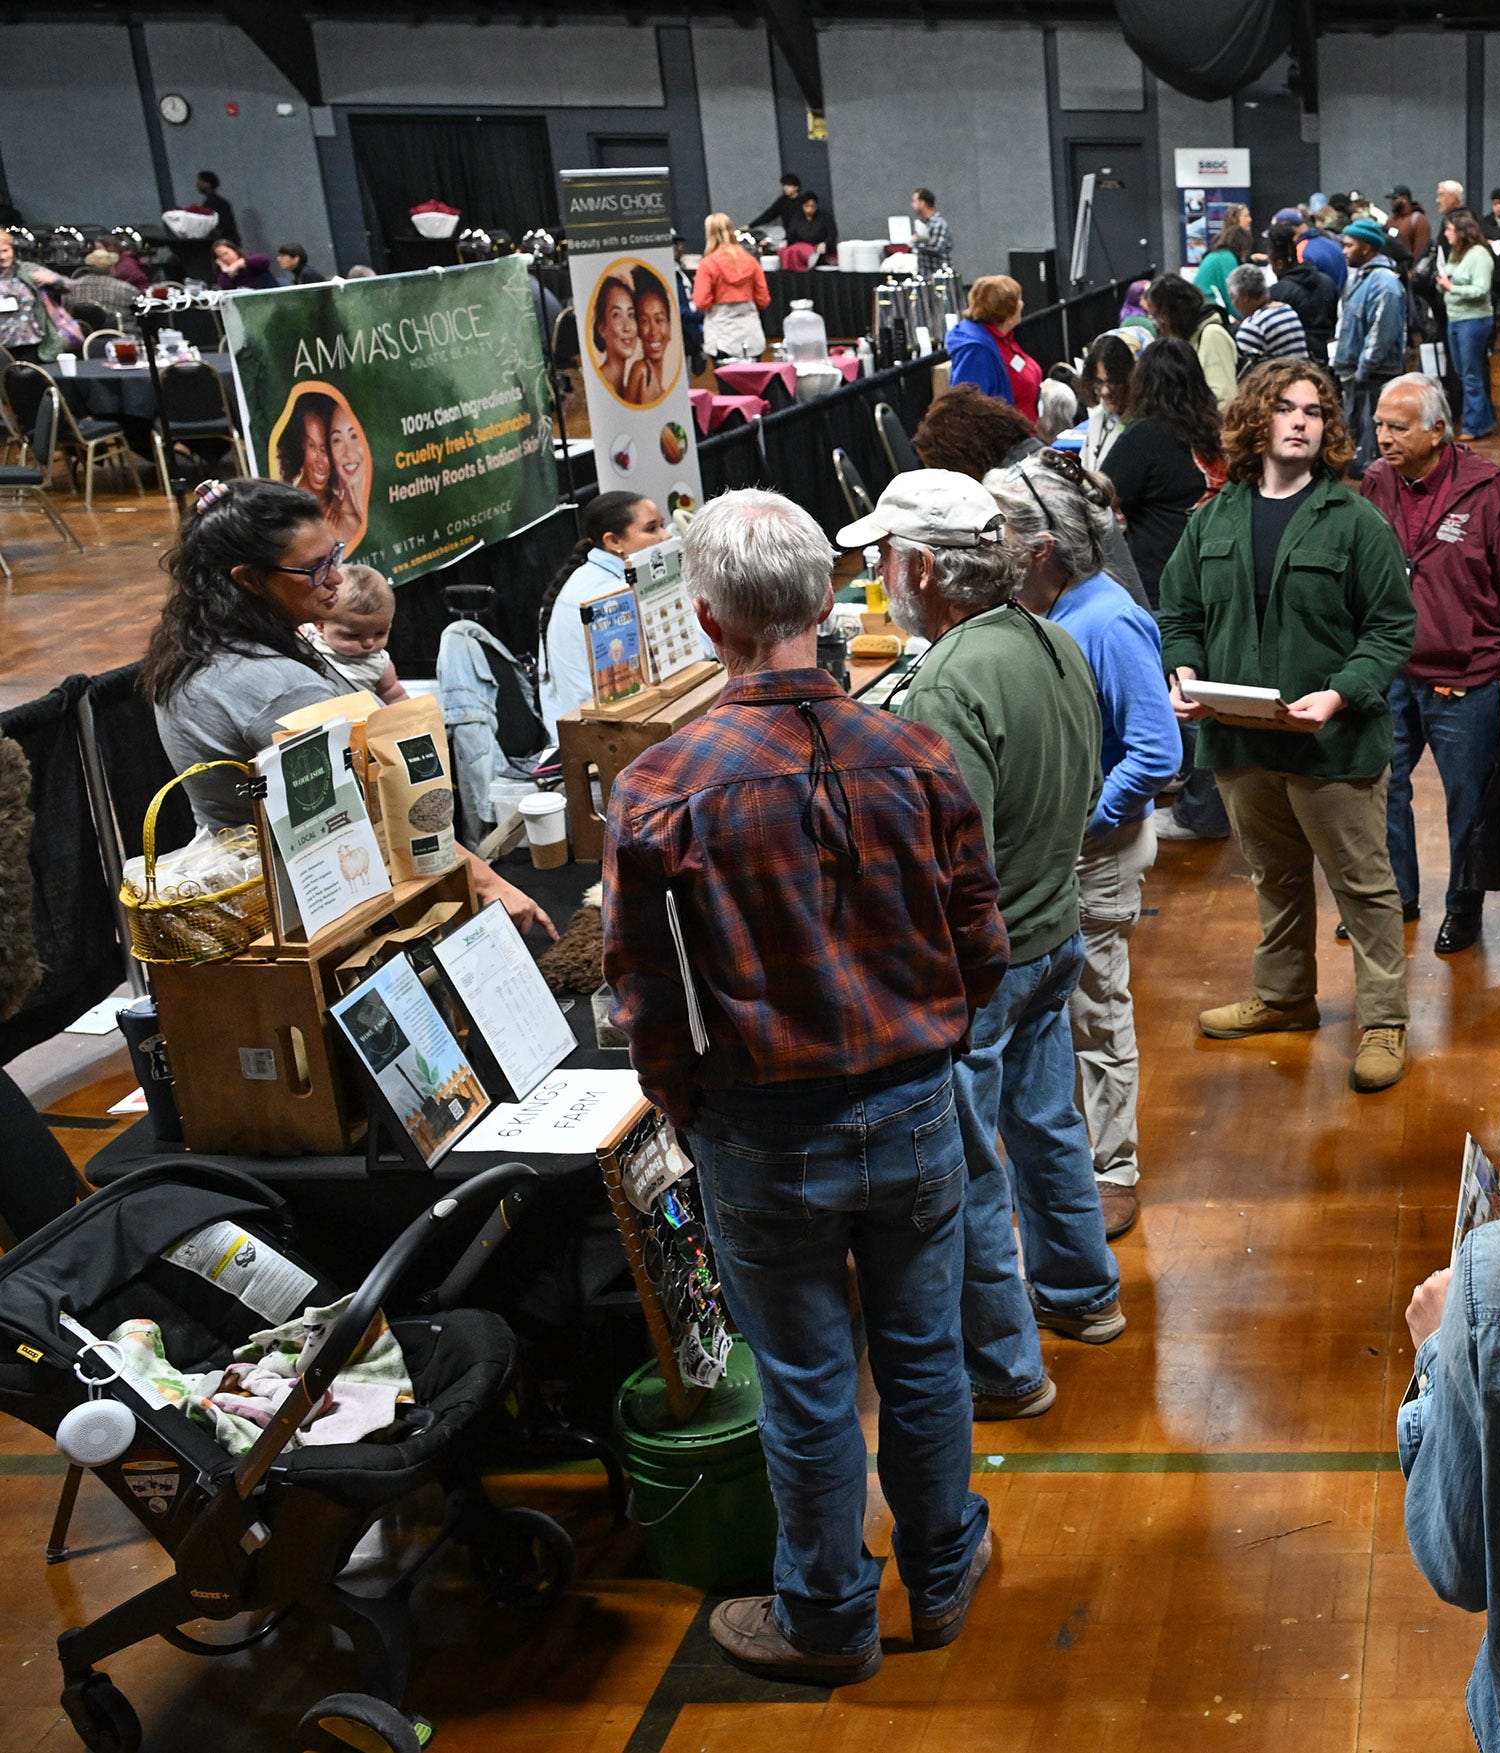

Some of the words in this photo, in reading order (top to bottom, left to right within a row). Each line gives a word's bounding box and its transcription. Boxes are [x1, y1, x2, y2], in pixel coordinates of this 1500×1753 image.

[570, 194, 619, 213] AMMA'S
[620, 192, 665, 210] CHOICE
[294, 322, 400, 378] AMMA'S
[399, 304, 491, 354] CHOICE
[401, 412, 435, 436] 100%
[434, 404, 462, 427] Clean
[460, 386, 523, 420] Ingredients
[395, 442, 444, 470] Cruelty
[445, 436, 467, 455] free
[465, 431, 475, 447] &
[389, 474, 441, 503] Healthy
[442, 462, 476, 487] Roots
[476, 457, 487, 475] &
[485, 443, 523, 471] Radiant
[392, 533, 426, 555] WITH
[432, 528, 440, 542] A
[446, 499, 513, 536] CONSCIENCE
[297, 831, 316, 846] LOCAL
[553, 1091, 607, 1129] FARM
